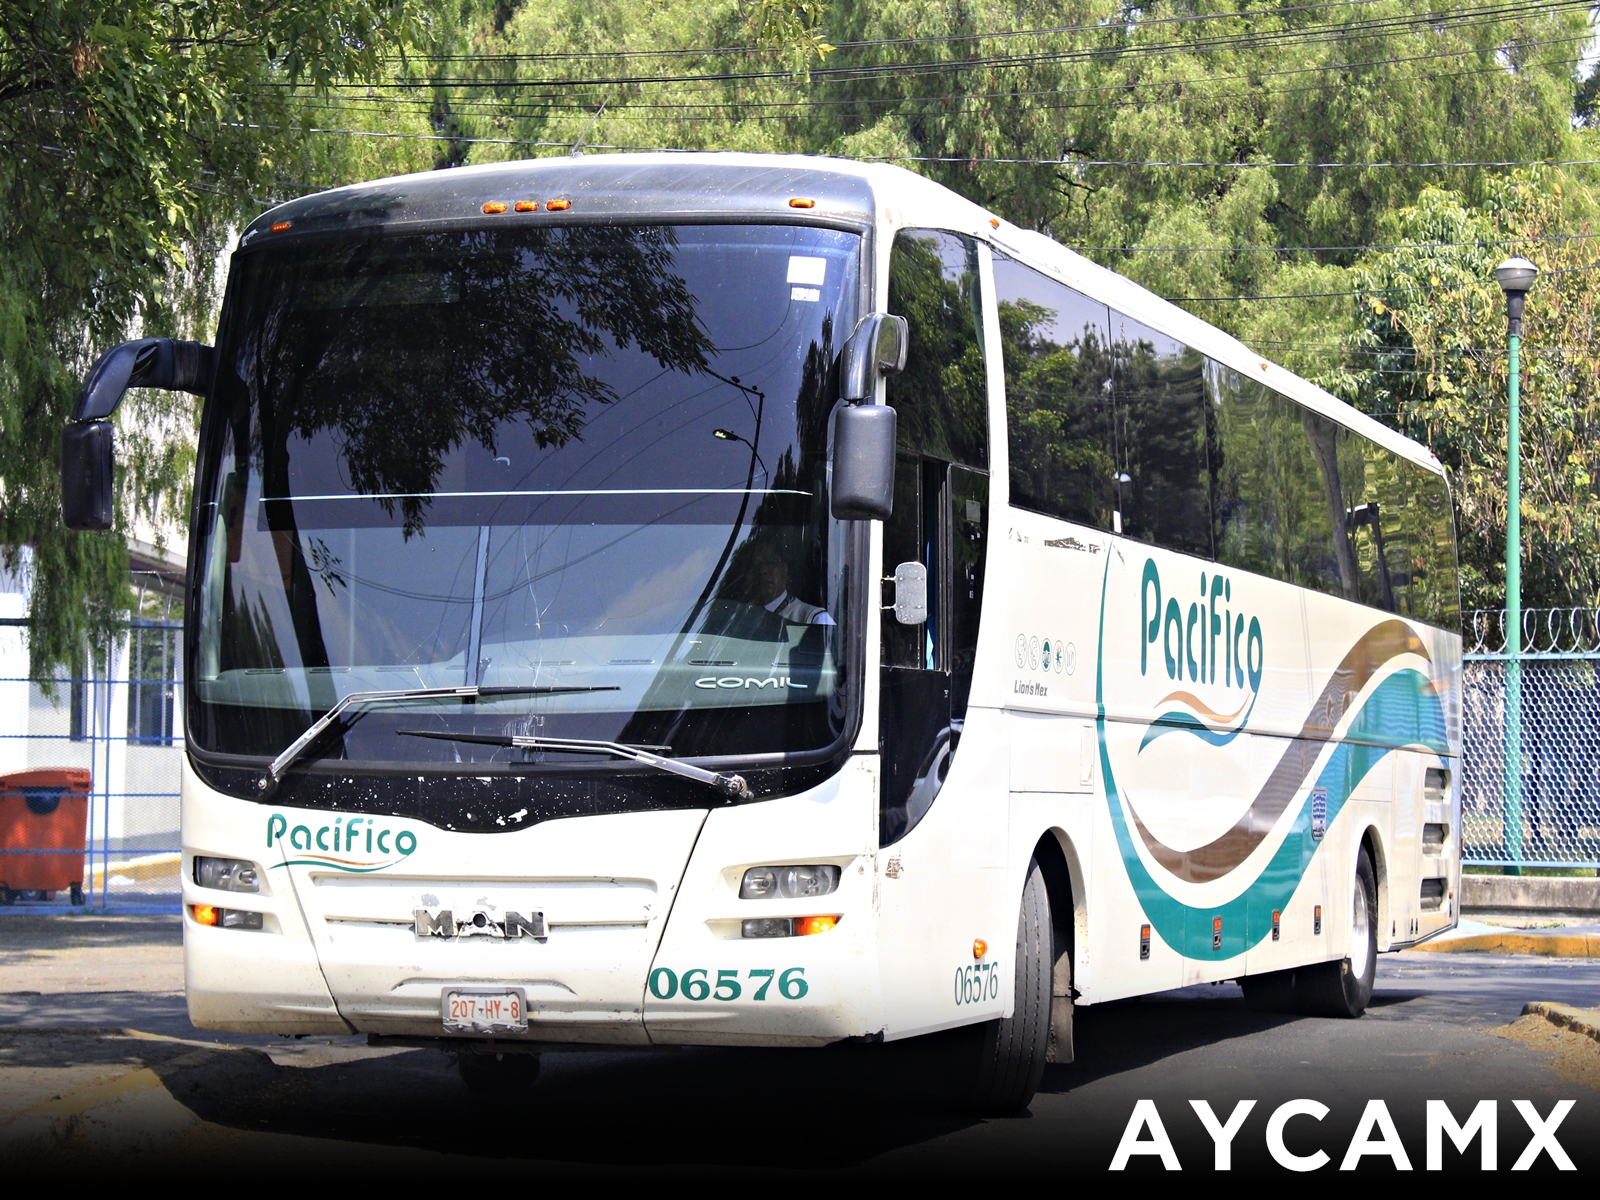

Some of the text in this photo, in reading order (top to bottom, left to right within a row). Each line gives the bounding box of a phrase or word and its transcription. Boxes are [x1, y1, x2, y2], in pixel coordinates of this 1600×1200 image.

[695, 676, 808, 689] COMIL
[1014, 679, 1048, 697] Lion's Mex
[415, 909, 548, 938] MAN
[649, 967, 809, 1001] 06576
[954, 961, 998, 1006] 06576
[451, 1000, 519, 1019] 207-HY-8
